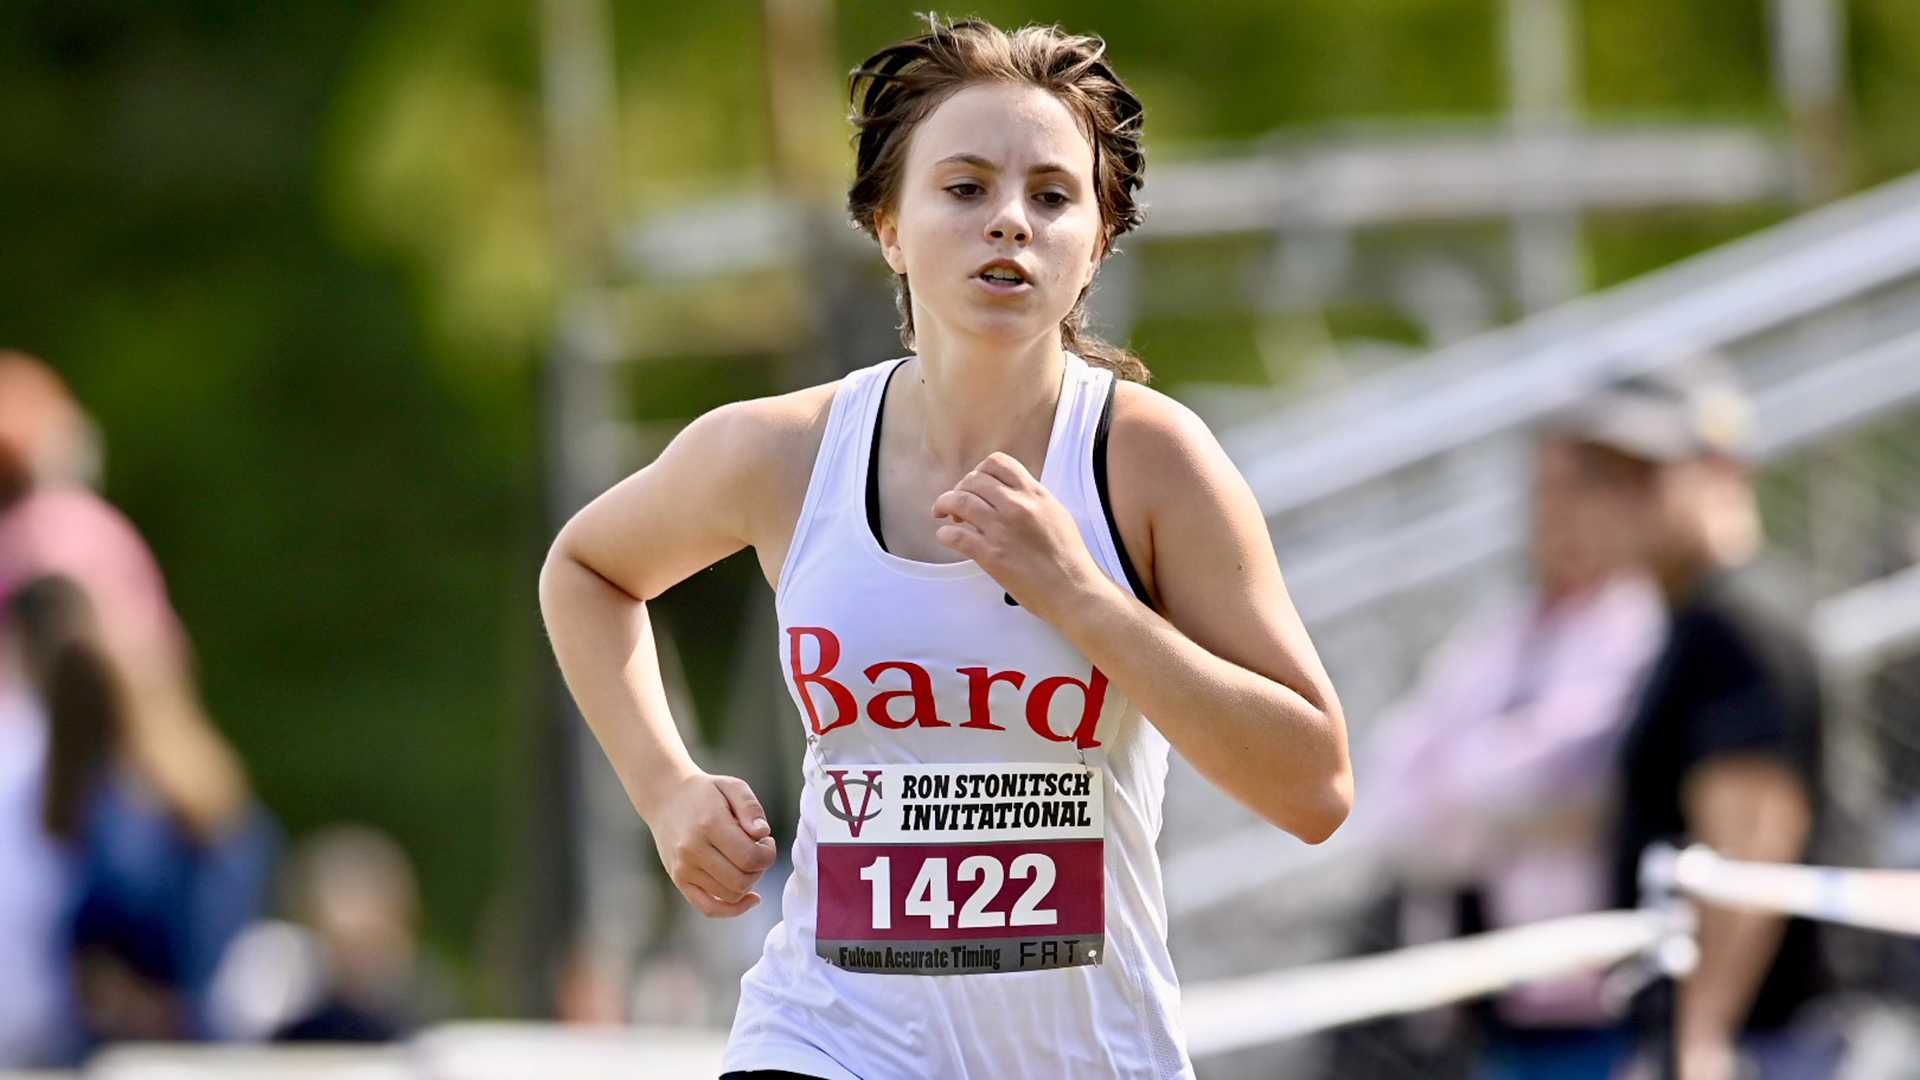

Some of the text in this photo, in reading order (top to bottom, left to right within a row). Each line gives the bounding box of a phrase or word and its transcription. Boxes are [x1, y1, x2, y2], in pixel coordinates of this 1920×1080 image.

[786, 626, 1109, 749] Bard
[901, 772, 1091, 799] RON STONITSCH
[900, 800, 1091, 831] INVITATIONAL
[859, 852, 1058, 930] 1422
[839, 944, 1001, 970] Fulton Accurate Timing
[1019, 939, 1081, 967] FAT
